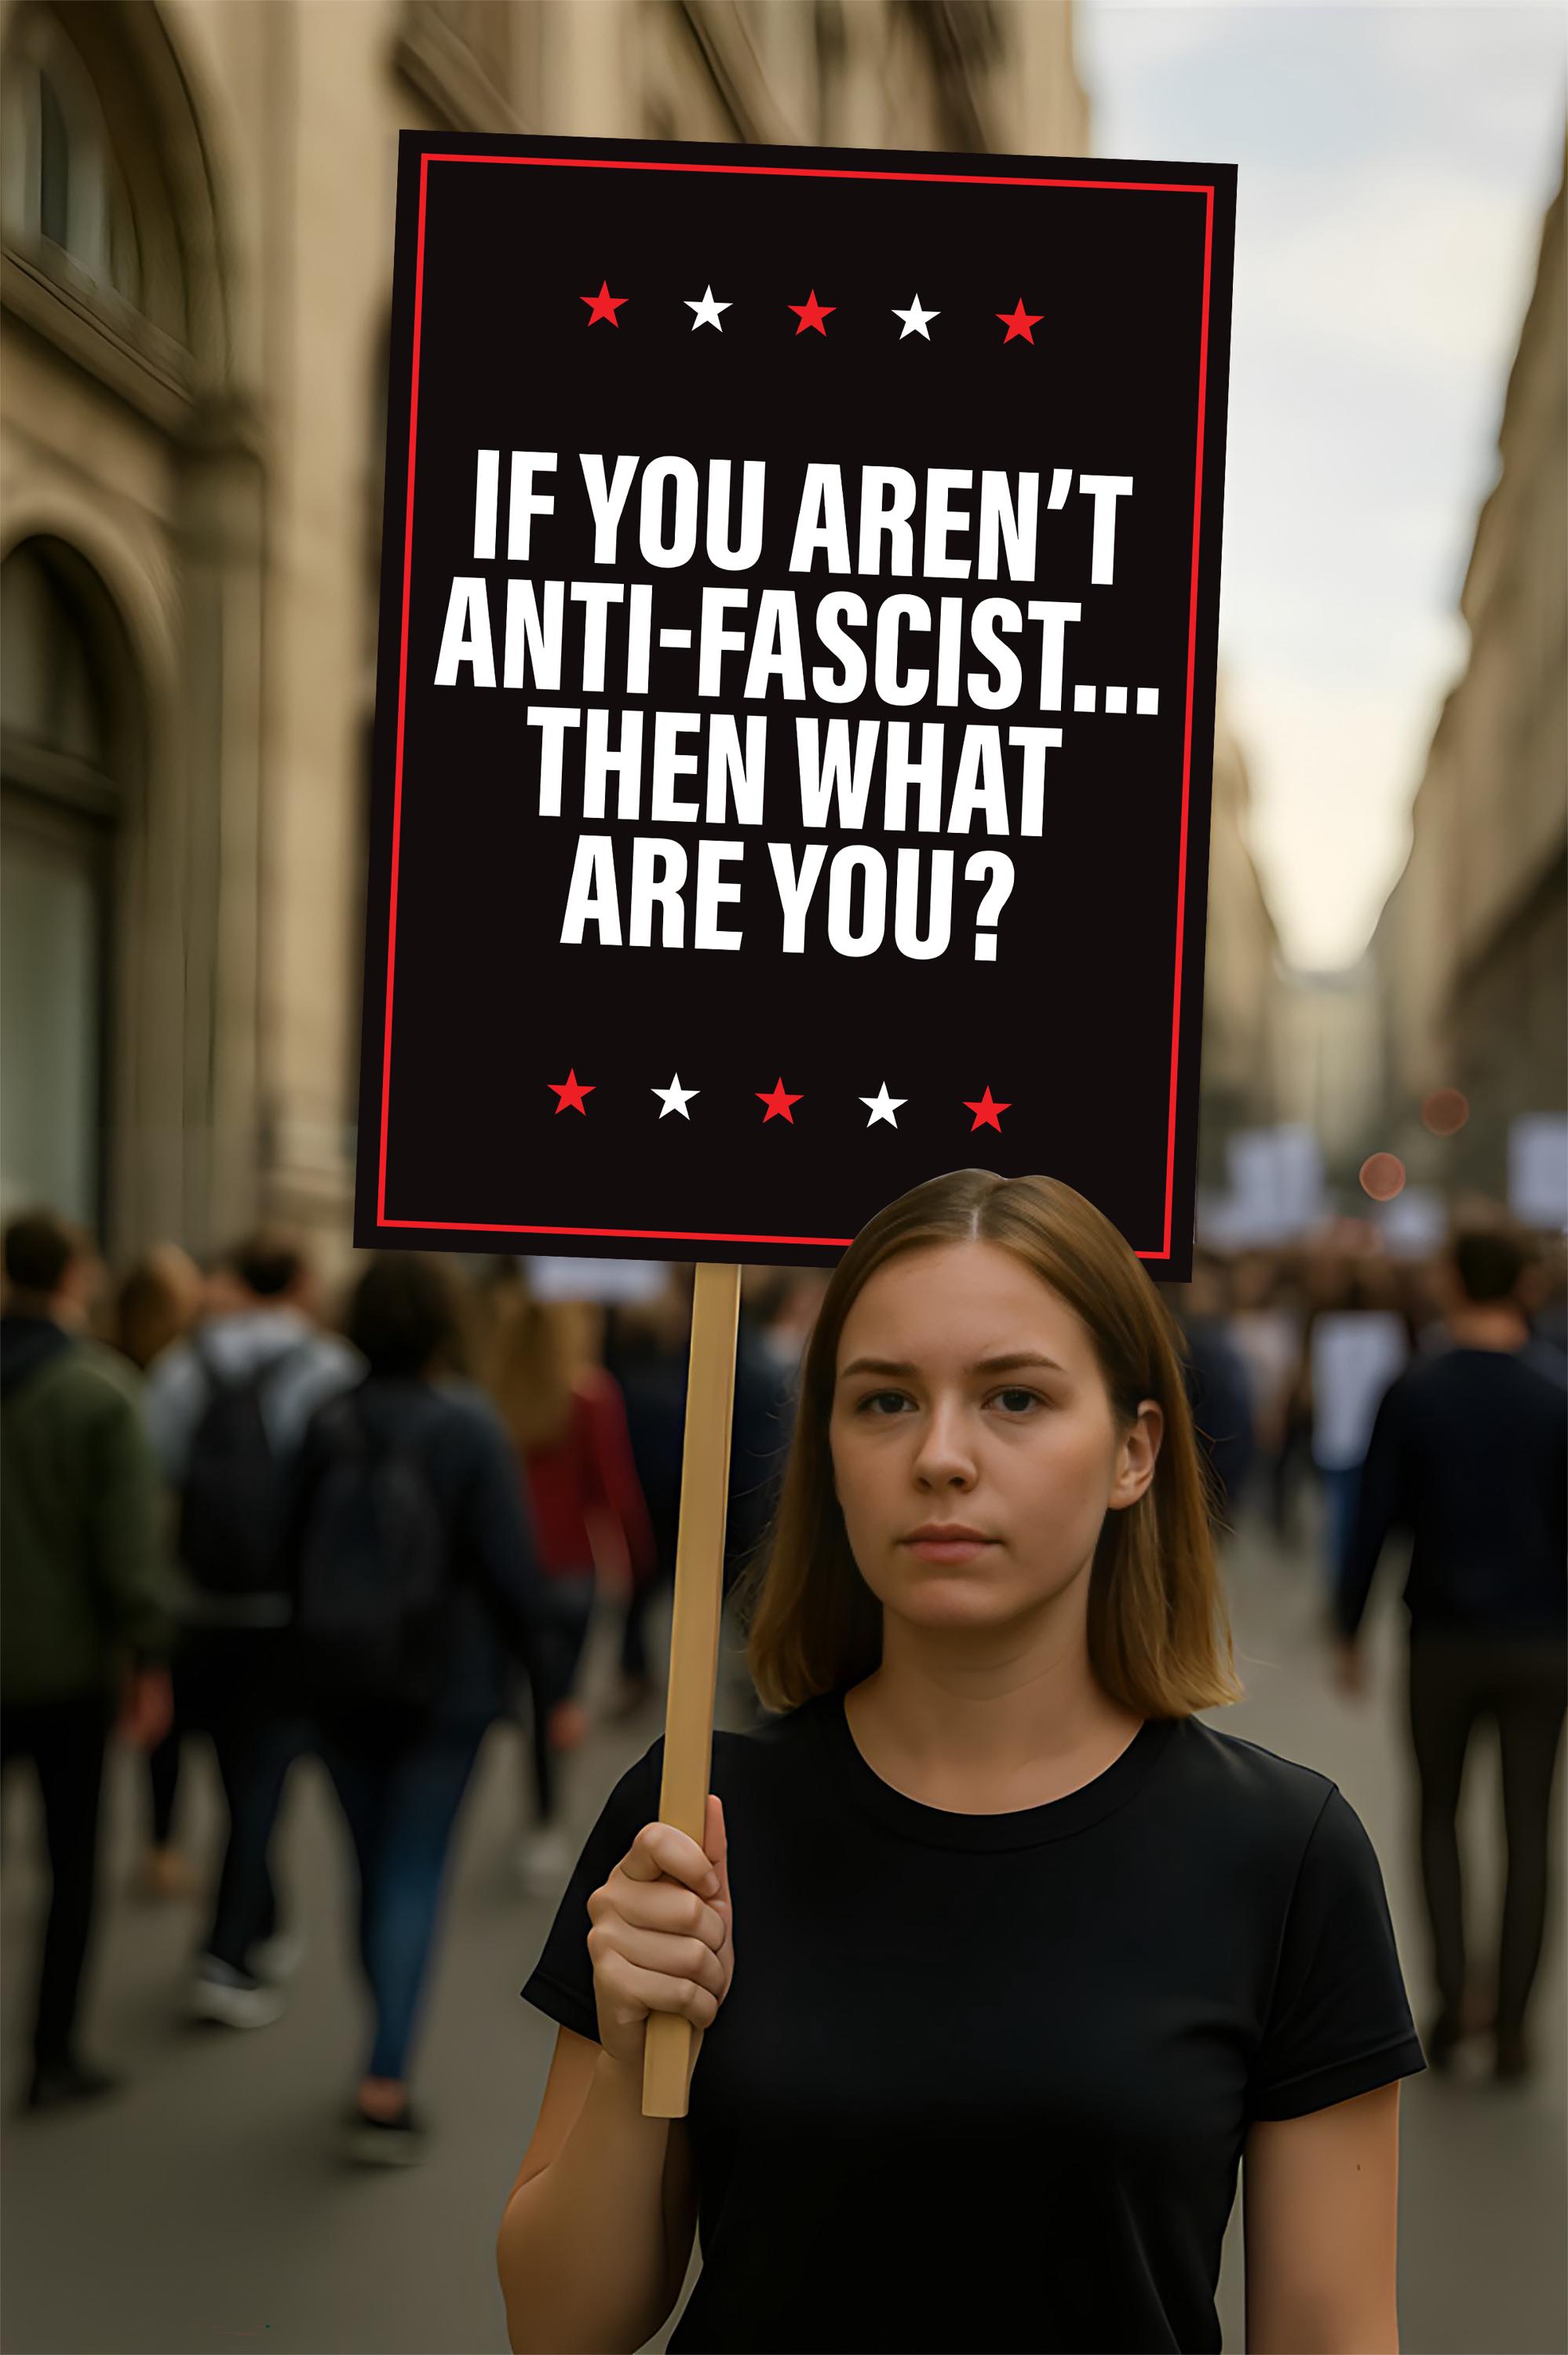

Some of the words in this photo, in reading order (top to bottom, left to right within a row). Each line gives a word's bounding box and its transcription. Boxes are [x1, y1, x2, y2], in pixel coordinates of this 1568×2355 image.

[474, 450, 557, 560] IF
[579, 454, 765, 571] YOU
[789, 464, 1133, 585] AREN’T
[434, 577, 1158, 714] ANTI-FASCIST...
[527, 706, 767, 825] THEN
[796, 717, 1063, 836] WHAT
[560, 835, 744, 950] ARE
[768, 843, 1014, 961] YOU?
